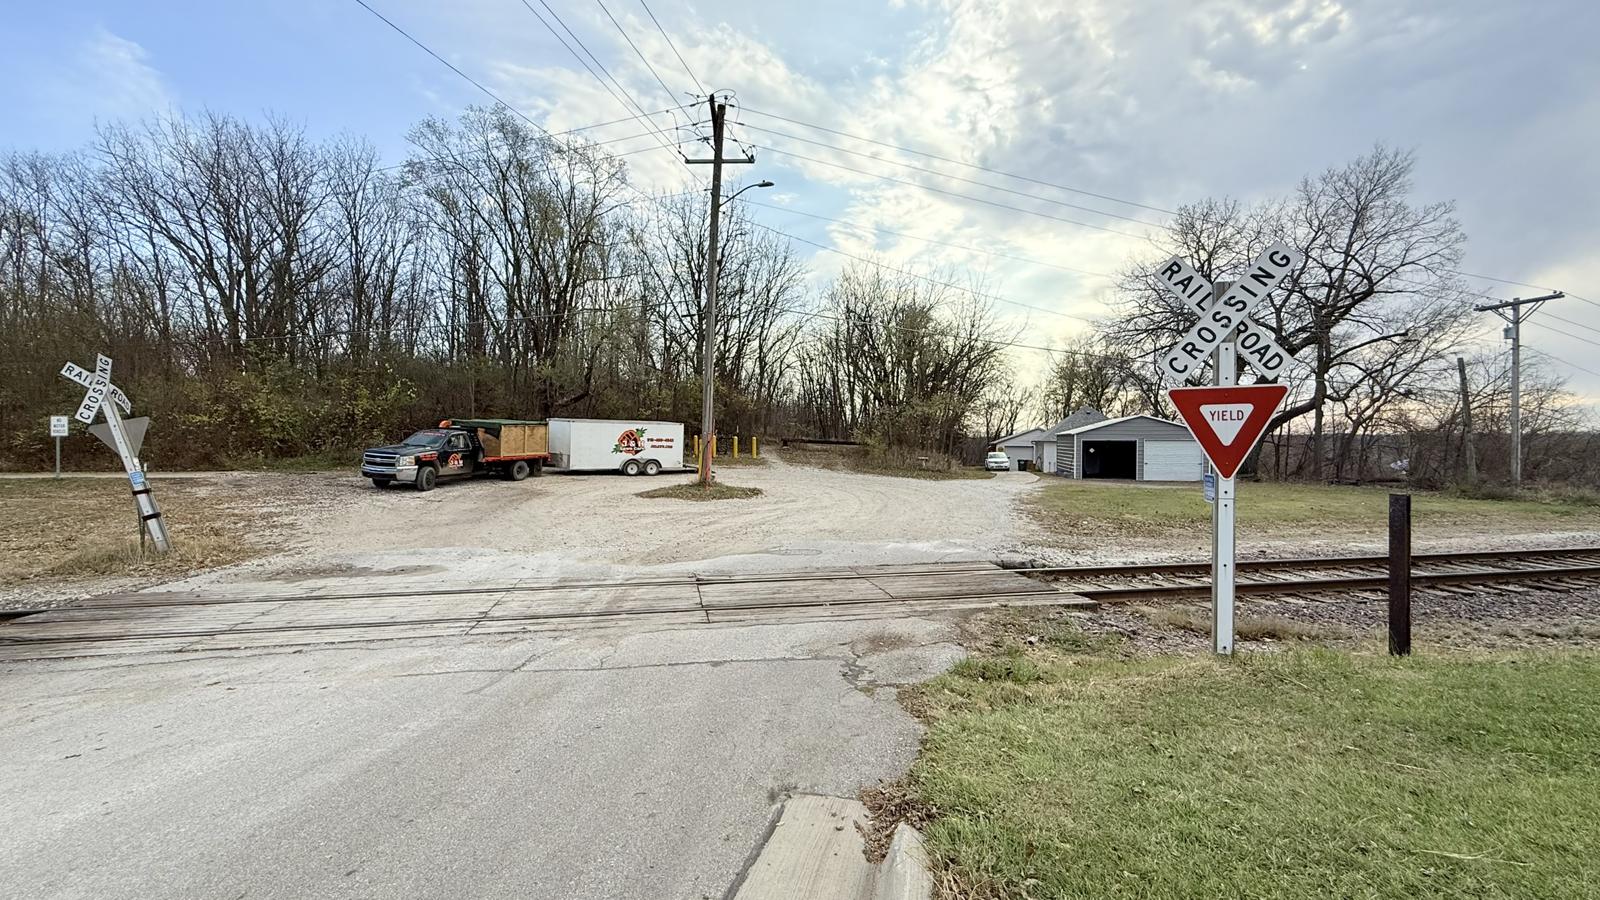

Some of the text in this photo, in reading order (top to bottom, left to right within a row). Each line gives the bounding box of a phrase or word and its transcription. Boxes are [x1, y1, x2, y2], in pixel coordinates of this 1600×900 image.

[1161, 261, 1284, 371] RAIL ROAD
[1168, 250, 1291, 374] CROSSING
[79, 357, 110, 421] CROSSING
[110, 388, 130, 411] ROAD
[1209, 410, 1244, 421] YIELD
